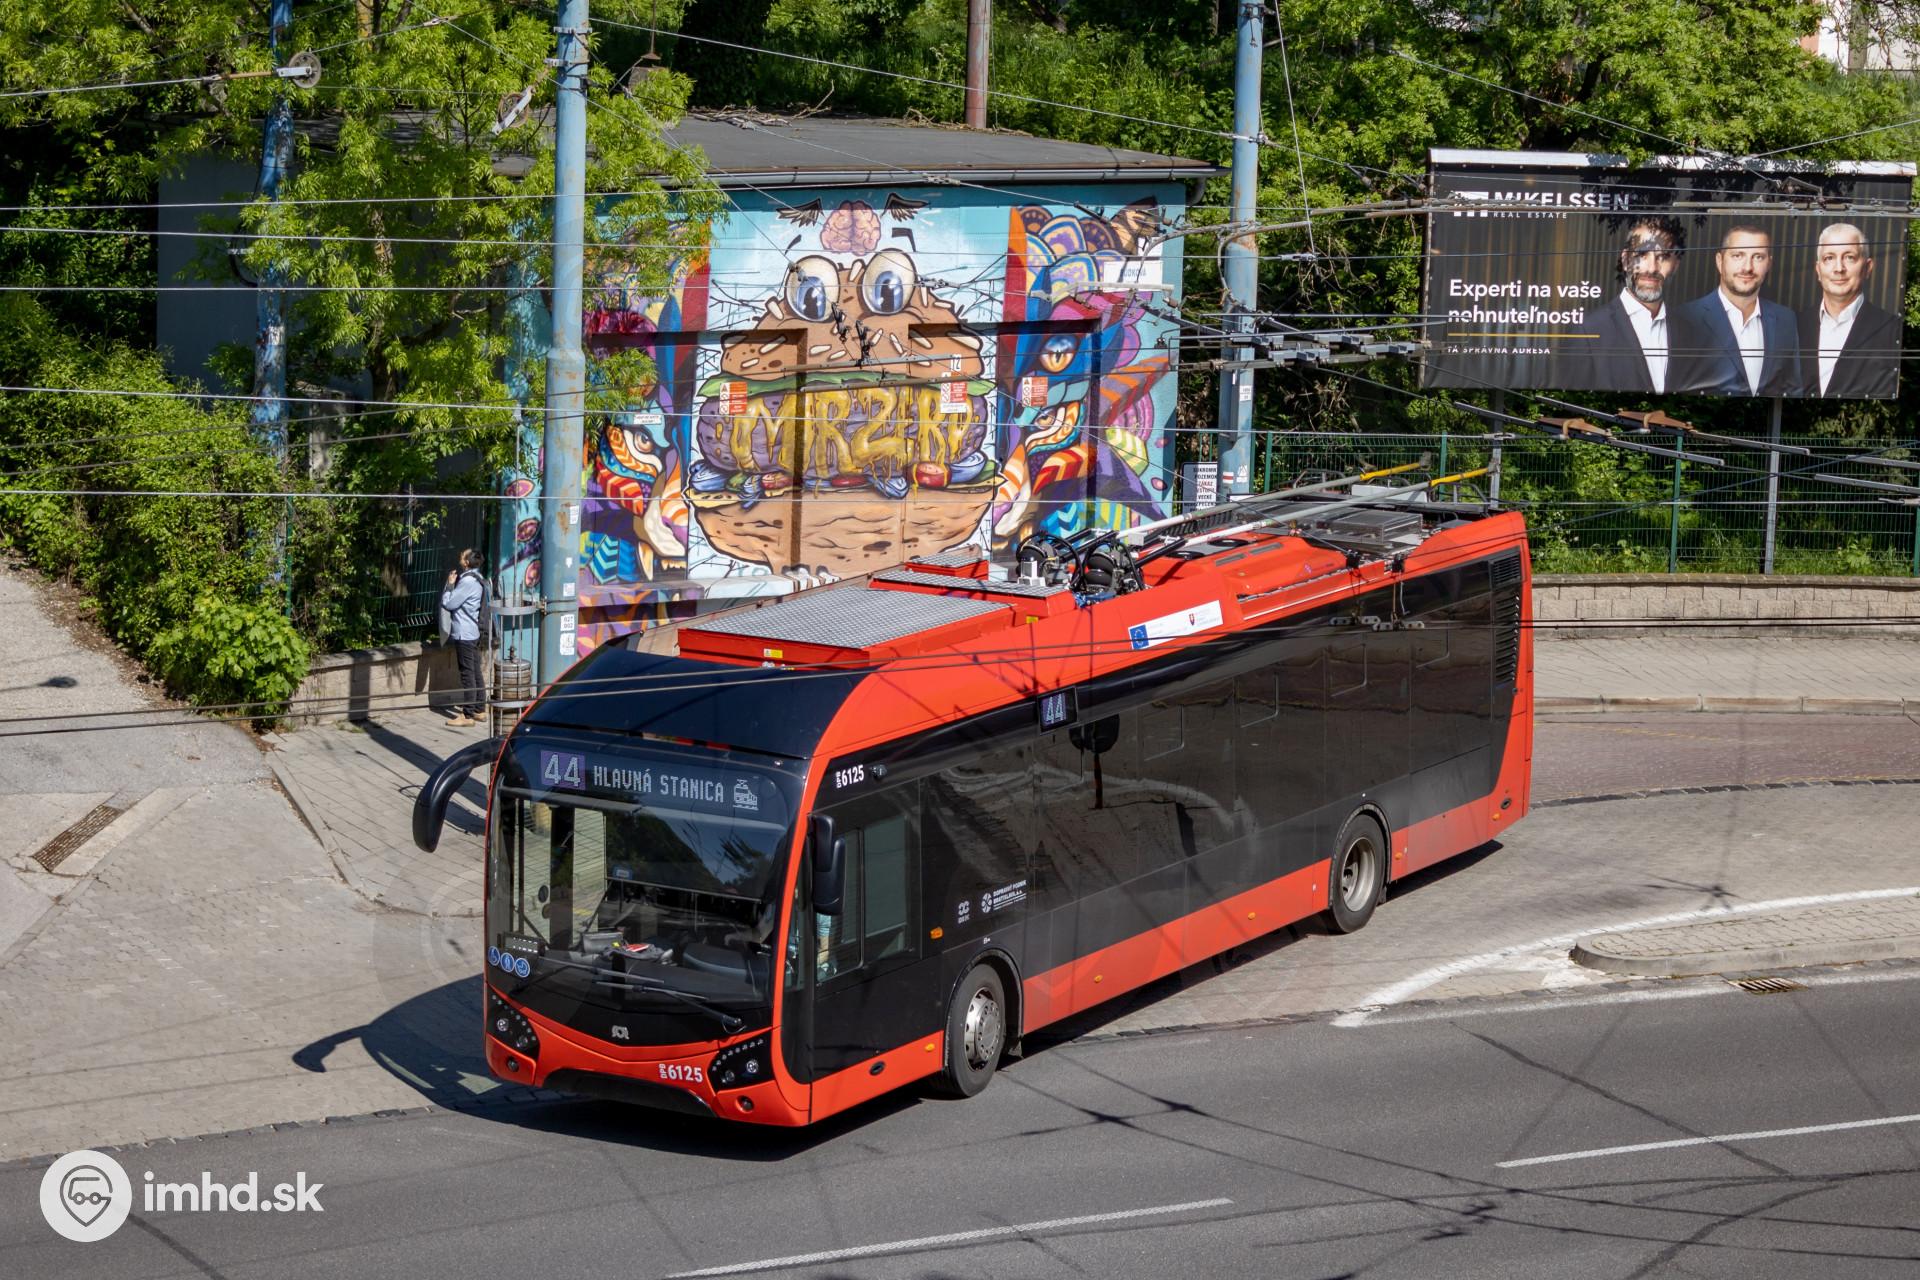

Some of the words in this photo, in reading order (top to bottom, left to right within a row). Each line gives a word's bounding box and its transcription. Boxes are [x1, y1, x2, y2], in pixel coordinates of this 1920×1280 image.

[1450, 279, 1522, 301] Experti
[1528, 284, 1551, 298] na
[1557, 281, 1601, 298] vaše
[1448, 305, 1584, 324] nehnuteľnosti
[1046, 694, 1064, 723] 44
[544, 754, 581, 787] 44
[593, 766, 652, 793] HLAVNÁ
[660, 775, 724, 803] STANICA
[842, 764, 864, 786] 6125
[668, 1065, 703, 1082] 6125
